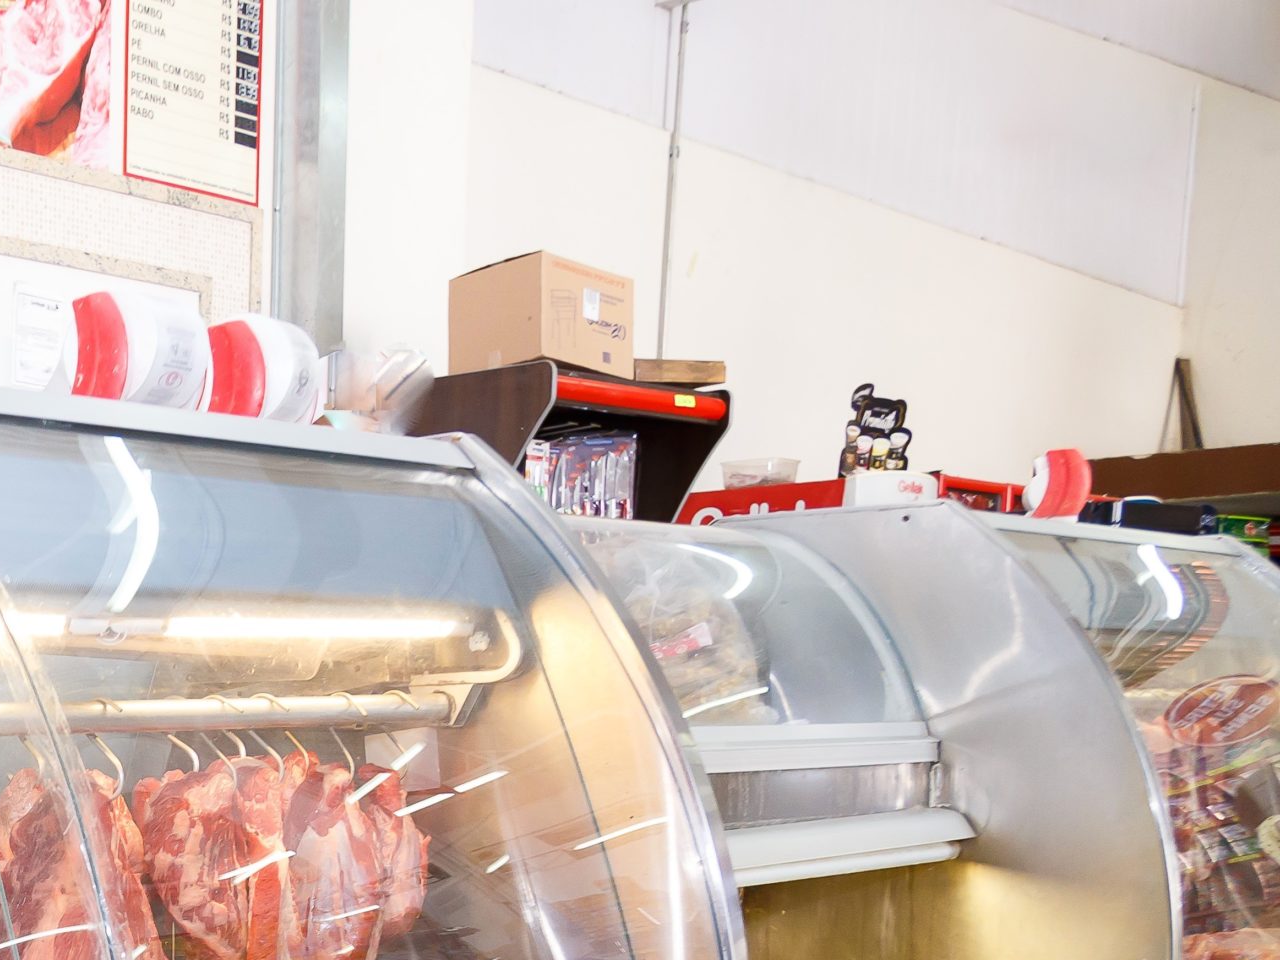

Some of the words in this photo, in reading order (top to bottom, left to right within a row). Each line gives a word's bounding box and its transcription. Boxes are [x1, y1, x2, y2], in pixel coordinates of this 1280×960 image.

[132, 2, 163, 19] LOMBO
[131, 19, 166, 37] ORELHA
[130, 54, 160, 71] PERNIL
[162, 62, 181, 76] COM
[183, 69, 206, 84] OSSO
[130, 71, 160, 88] PERNIL
[162, 80, 180, 93] SEM
[181, 86, 205, 100] OSSO
[130, 87, 167, 106] PICANHA
[130, 105, 154, 120] RABO
